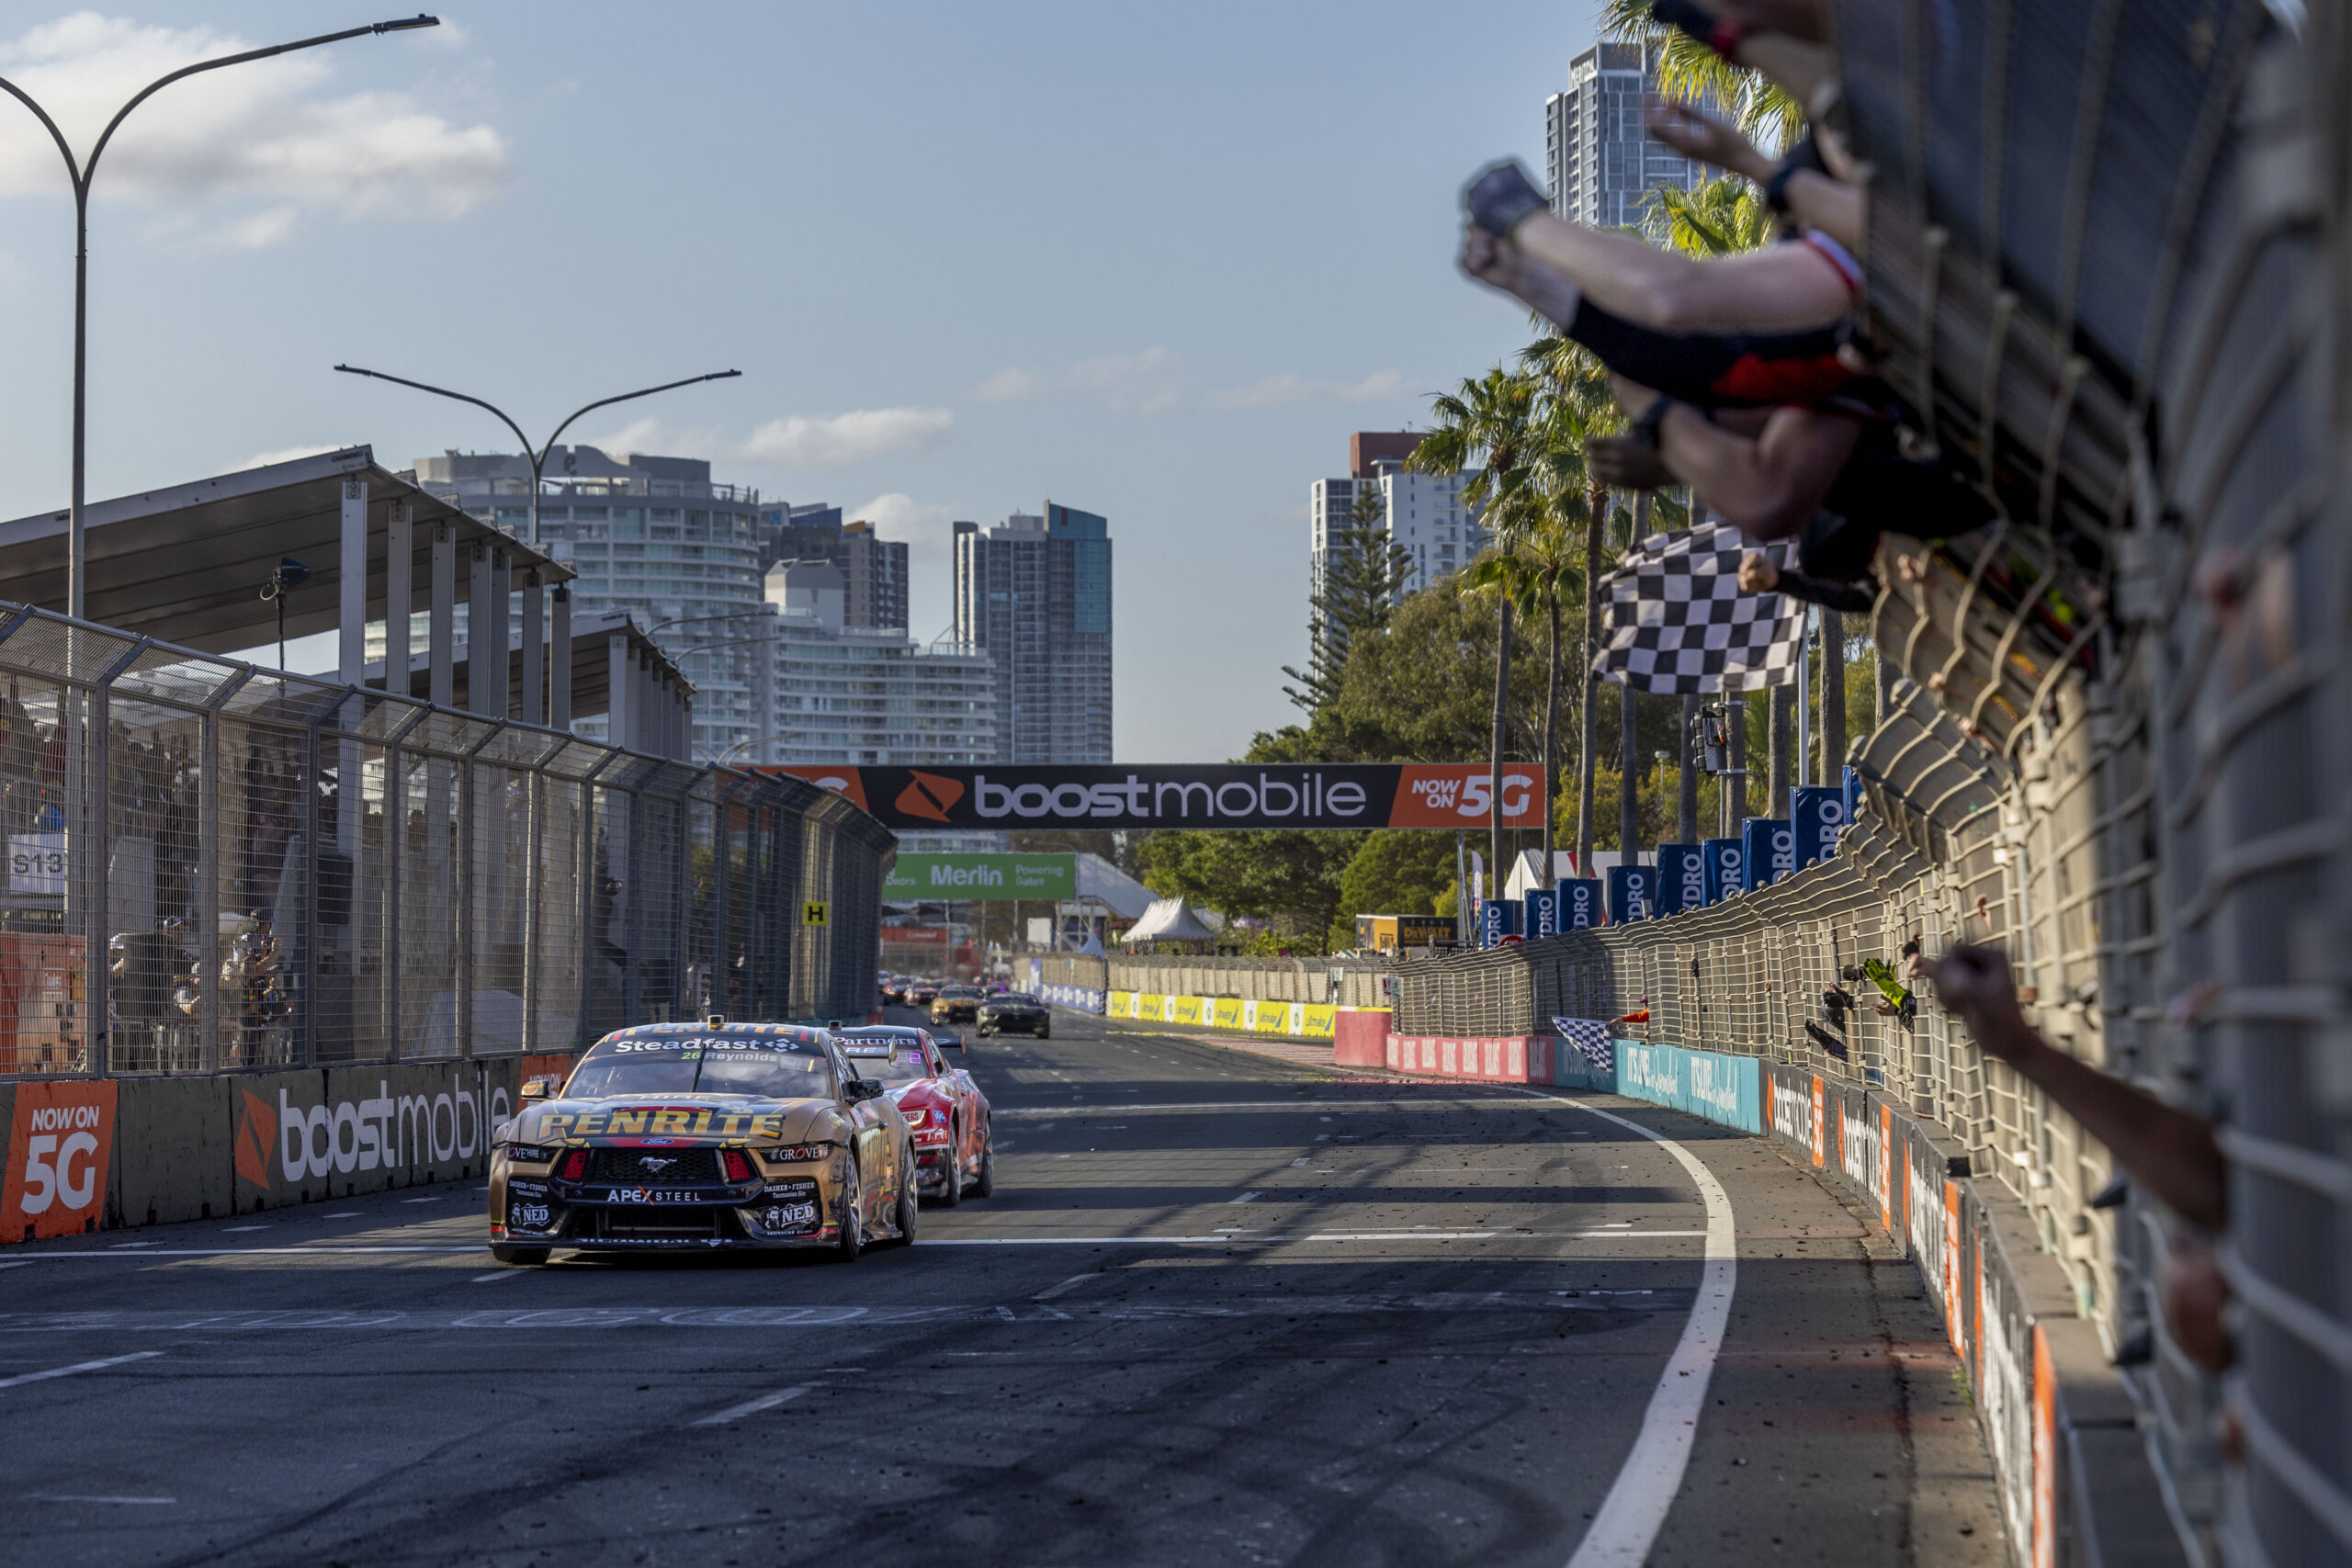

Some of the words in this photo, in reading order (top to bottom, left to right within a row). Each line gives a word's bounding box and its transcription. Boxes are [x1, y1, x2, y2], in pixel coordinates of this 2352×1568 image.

[1411, 779, 1461, 794] NOW
[1426, 794, 1455, 807] ON
[1456, 774, 1533, 817] 5G
[14, 852, 62, 874] S13
[1015, 864, 1064, 876] Powering
[931, 864, 1003, 886] Merlin
[1015, 876, 1045, 886] Gates
[808, 906, 824, 921] H
[615, 1038, 761, 1053] Steadfast
[681, 1052, 701, 1060] 26
[704, 1052, 778, 1062] Reynolds
[31, 1107, 75, 1131] NOW
[75, 1105, 100, 1129] ON
[537, 1110, 784, 1140] PENRITE
[779, 1148, 818, 1160] GROVE
[20, 1132, 98, 1214] 5G
[792, 1182, 814, 1190] FISHER
[656, 1192, 701, 1201] STEEL
[524, 1209, 548, 1222] NED
[783, 1205, 814, 1223] NED
